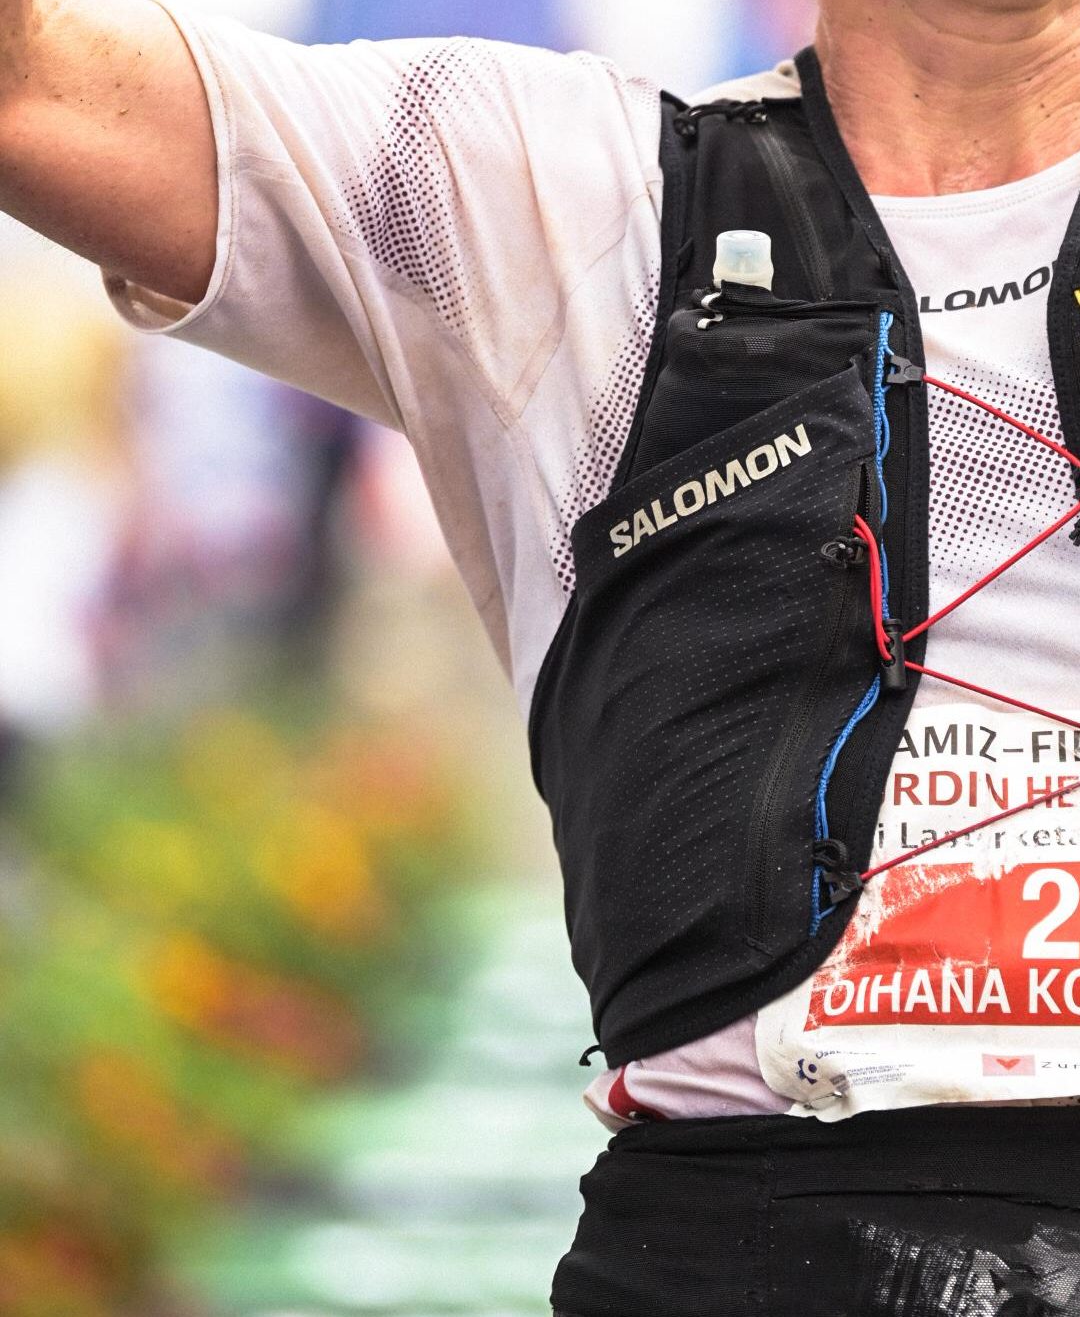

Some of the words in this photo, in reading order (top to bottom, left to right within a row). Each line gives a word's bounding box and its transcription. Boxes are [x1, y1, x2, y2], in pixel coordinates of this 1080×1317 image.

[919, 263, 1058, 314] LOMO
[609, 423, 813, 559] SALOMON
[1021, 868, 1080, 961] 2
[823, 968, 1011, 1017] OIHANA
